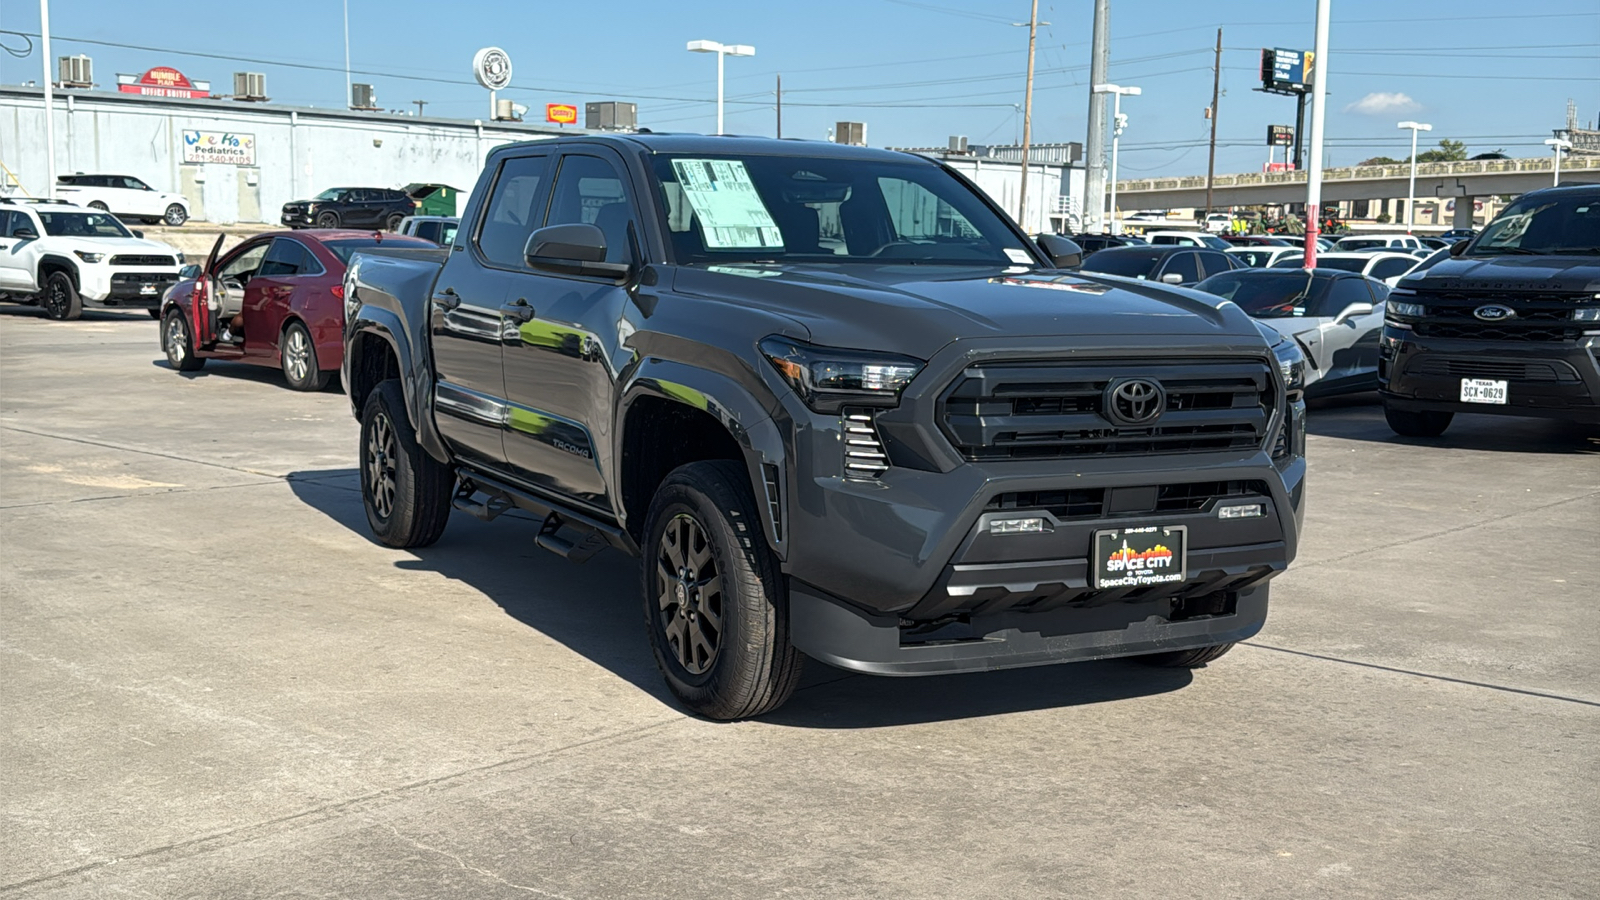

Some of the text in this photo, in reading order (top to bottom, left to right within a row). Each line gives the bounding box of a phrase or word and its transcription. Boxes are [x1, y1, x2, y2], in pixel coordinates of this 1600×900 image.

[150, 70, 181, 81] HUMBLE
[195, 145, 244, 155] Pediatrics
[189, 153, 252, 164] 281-540-KIDS
[1481, 308, 1502, 317] Ford
[553, 439, 589, 458] TACOMA
[1107, 556, 1172, 571] SPACE CITY
[1100, 574, 1181, 588] SpaceCityToyota.com
